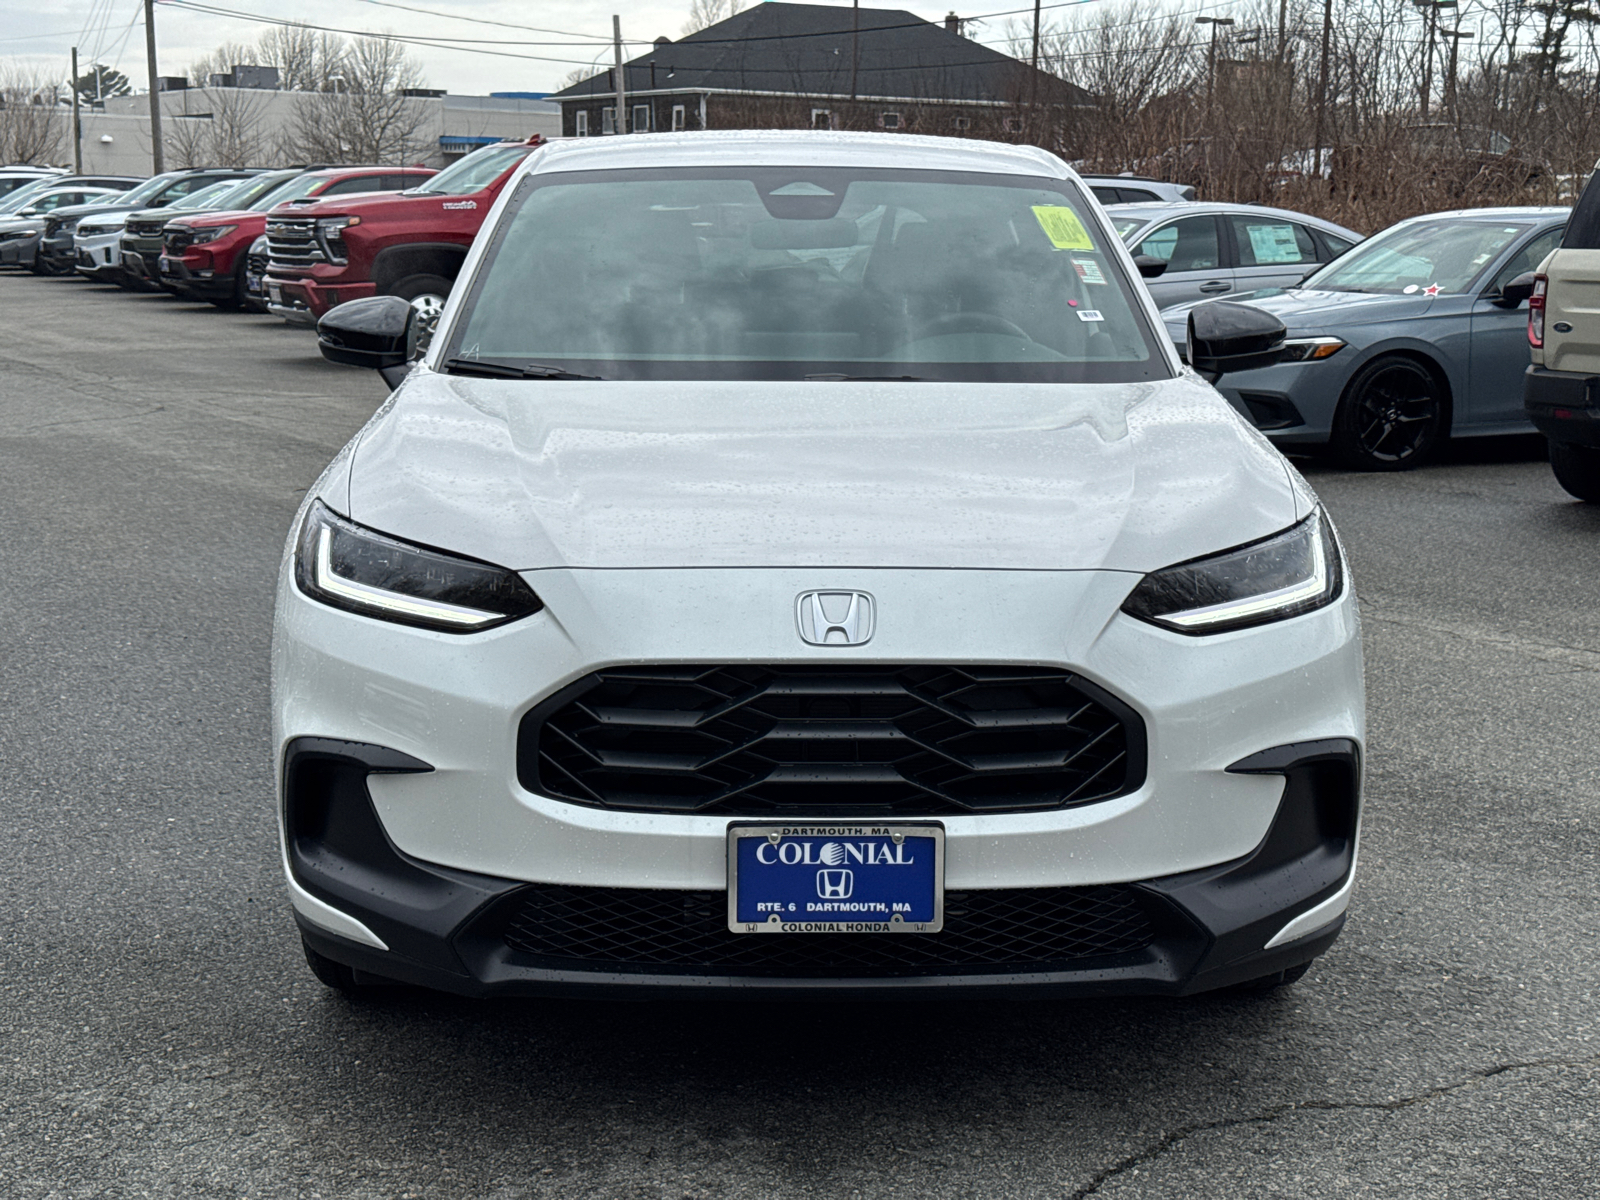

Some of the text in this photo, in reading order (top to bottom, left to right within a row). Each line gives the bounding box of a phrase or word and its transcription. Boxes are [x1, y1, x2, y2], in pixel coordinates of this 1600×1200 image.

[756, 842, 914, 866] COLONIAL
[757, 902, 912, 913] RTE. 6 DARTMOUTH, MA
[781, 923, 890, 932] COLONIAL HONDA
